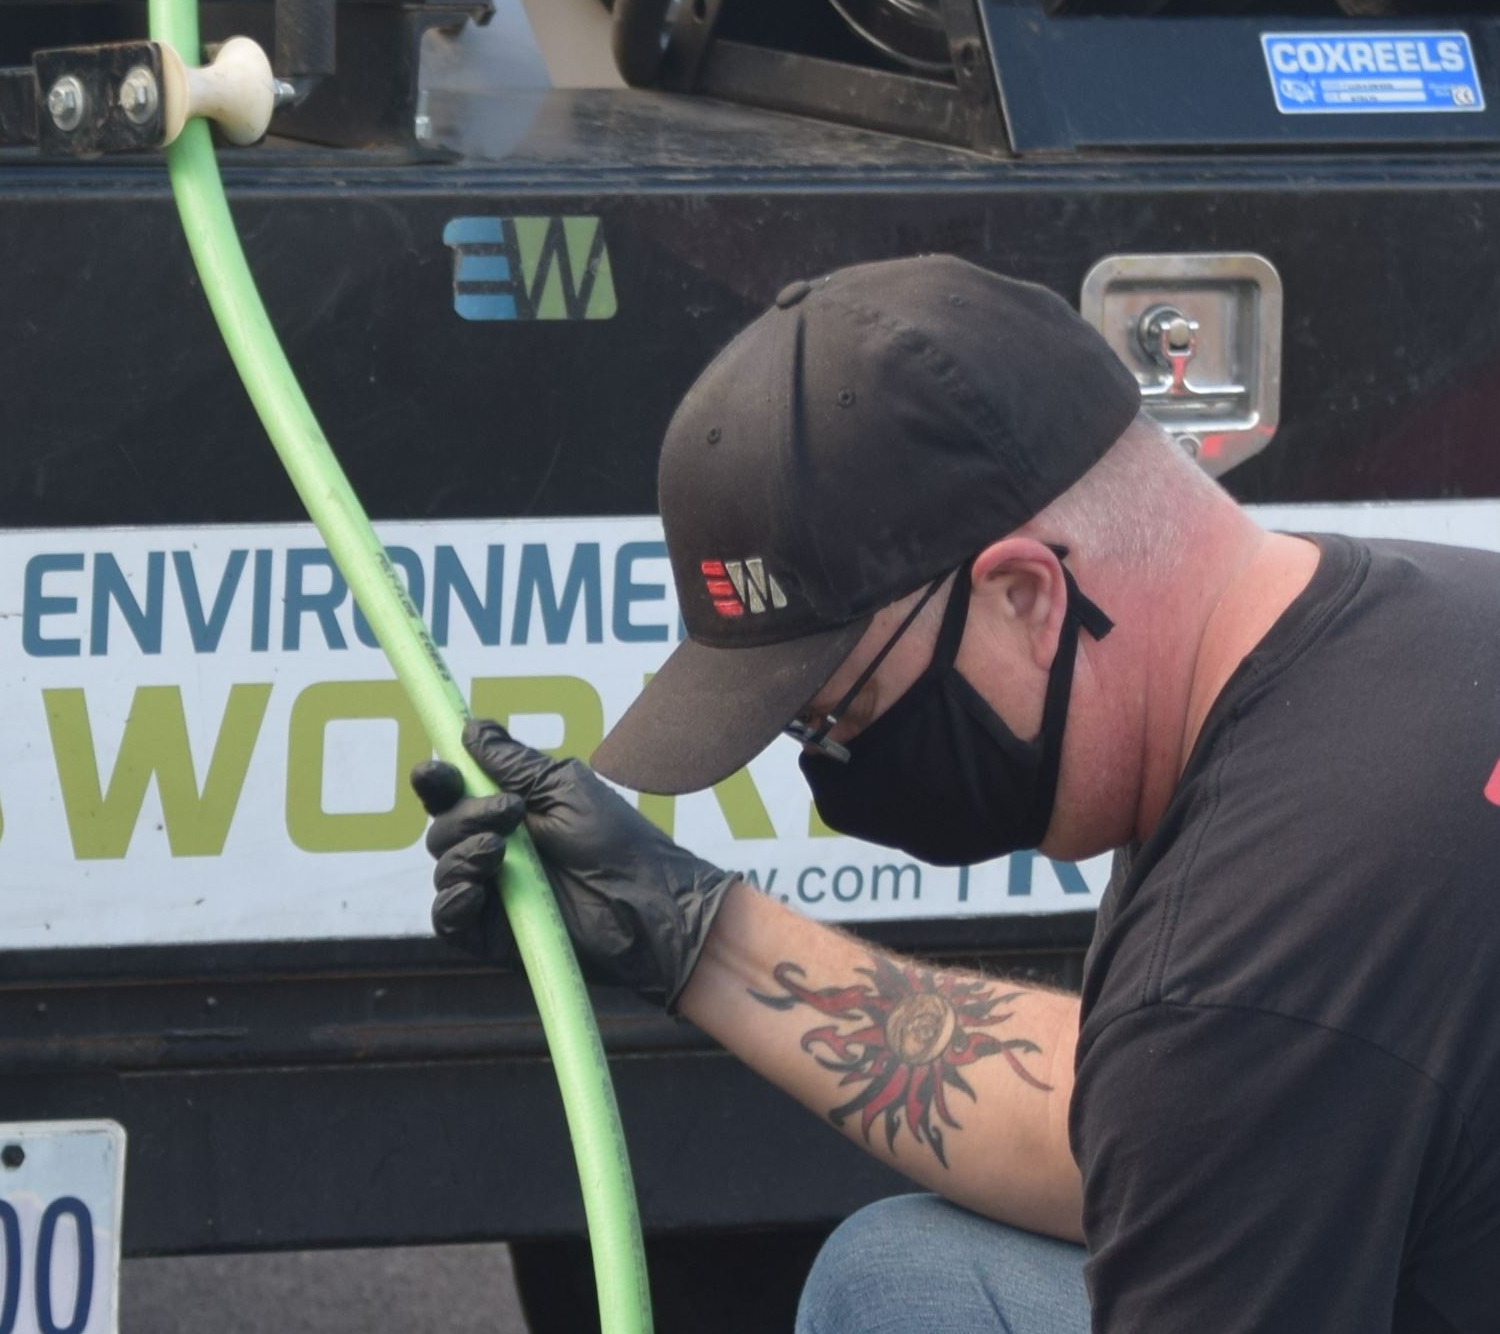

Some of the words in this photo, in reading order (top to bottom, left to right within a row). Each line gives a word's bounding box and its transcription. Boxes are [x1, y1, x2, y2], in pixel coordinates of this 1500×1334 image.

[1271, 41, 1465, 74] COXREELS
[443, 214, 619, 321] EW
[22, 540, 688, 658] ENVIRONME
[701, 557, 788, 616] EW
